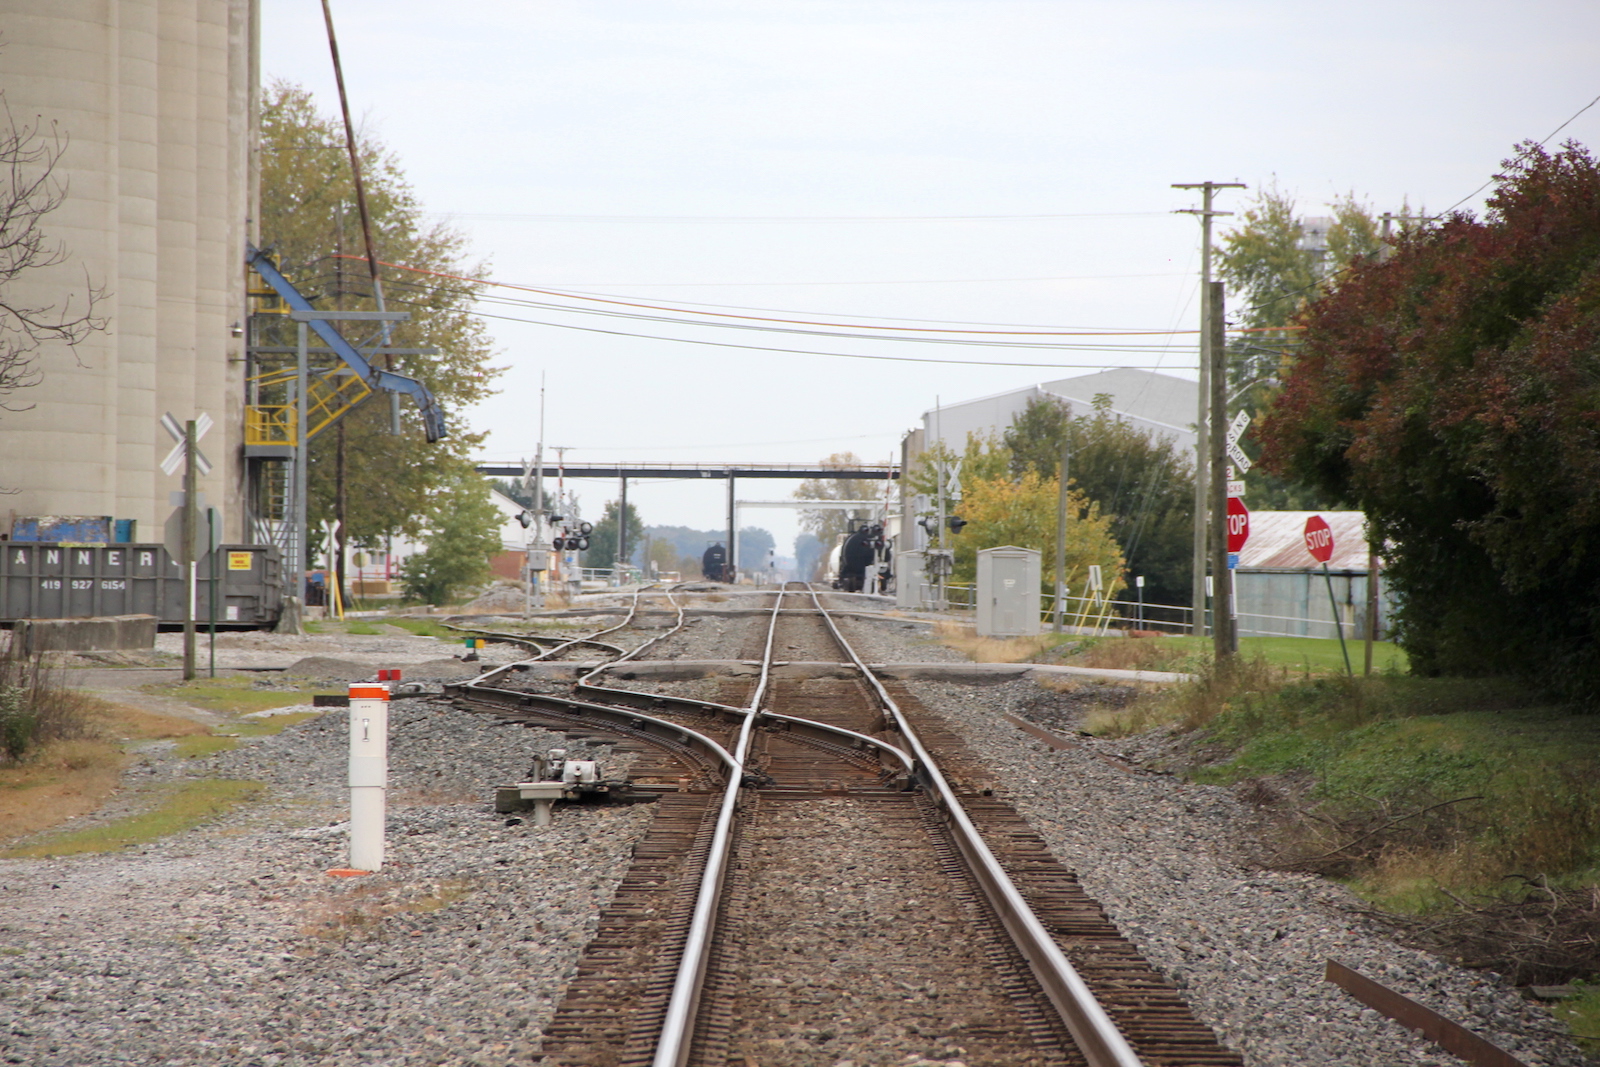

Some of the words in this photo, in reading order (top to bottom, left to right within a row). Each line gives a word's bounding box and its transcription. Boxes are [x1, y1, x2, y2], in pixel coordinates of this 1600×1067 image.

[1227, 514, 1247, 536] TOP
[1306, 528, 1331, 550] STOP
[14, 549, 178, 567] ANNER
[41, 580, 62, 590] 419
[71, 580, 93, 590] 927
[101, 580, 126, 590] 6154
